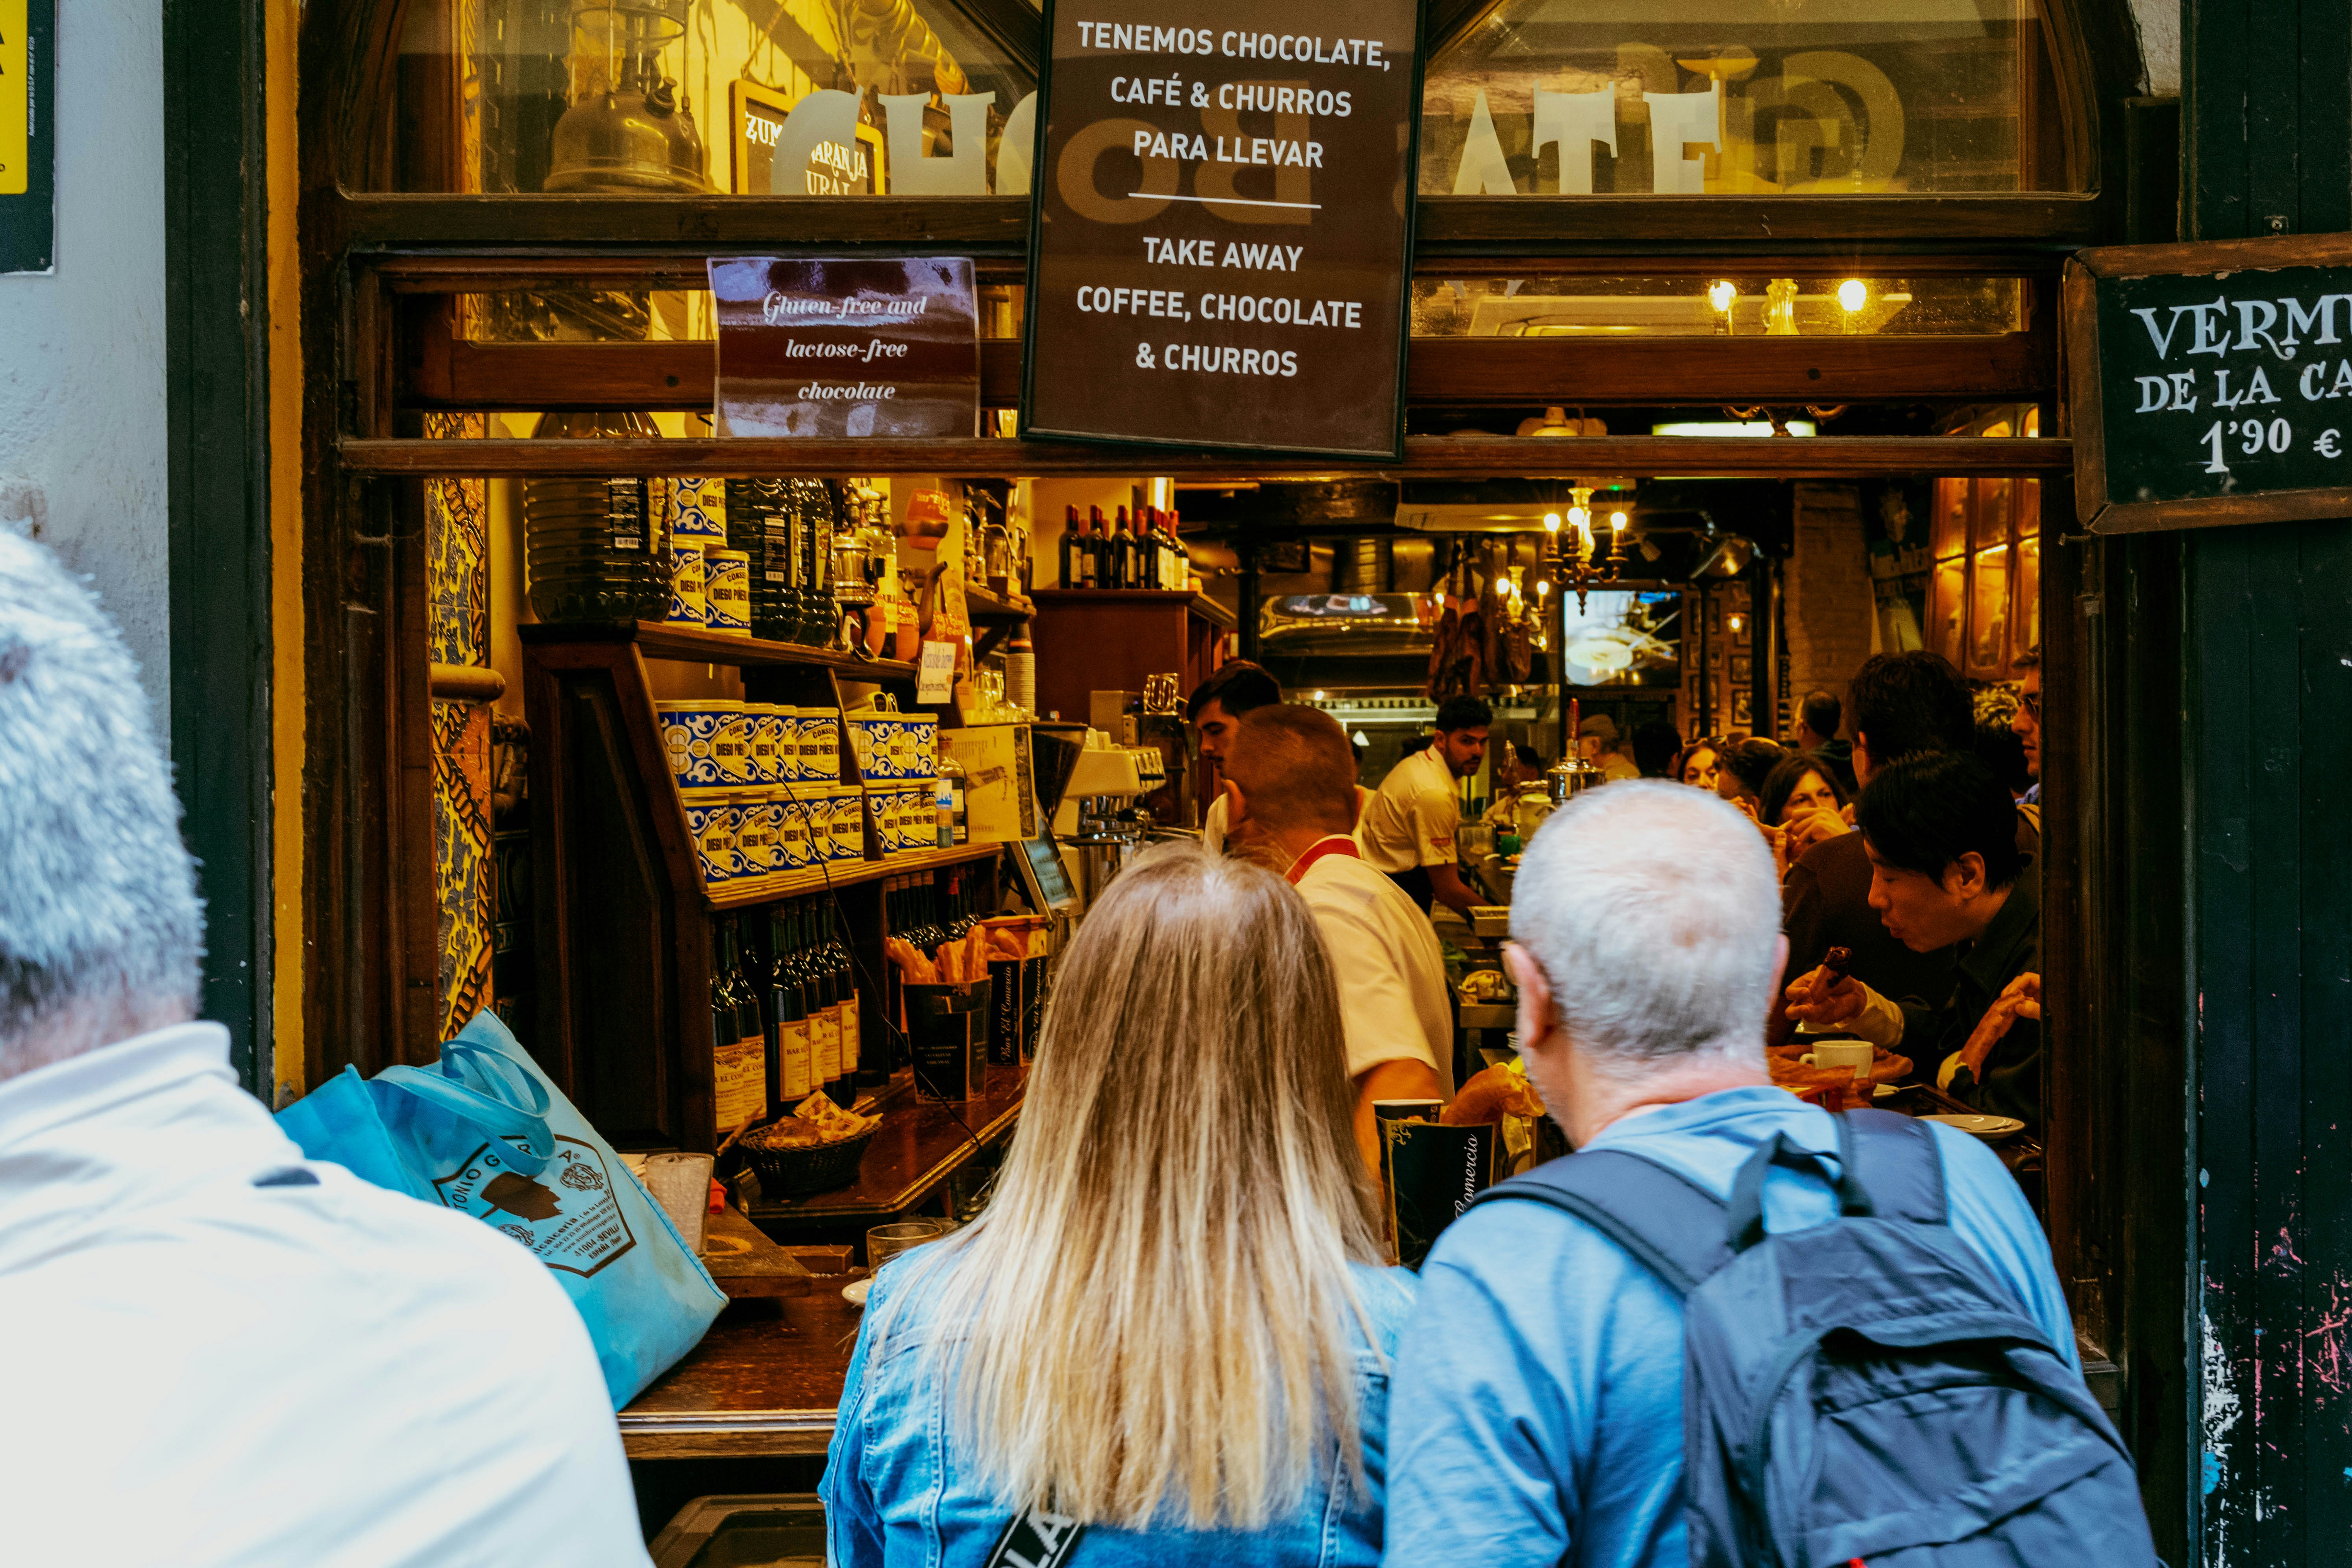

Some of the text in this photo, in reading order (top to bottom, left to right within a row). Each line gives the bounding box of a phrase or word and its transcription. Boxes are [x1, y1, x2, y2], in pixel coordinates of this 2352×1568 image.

[1077, 21, 1390, 72] TENEMOS CHOCOLATE,
[1110, 73, 1352, 117] CAFÉ & CHURROS
[745, 111, 783, 147] ZUM
[811, 141, 869, 181] ARANJA
[1134, 131, 1323, 168] PARA LLEVAR
[1143, 237, 1304, 272] TAKE AWAY
[763, 290, 927, 324] Gluten-free and
[1077, 286, 1362, 328] COFFEE, CHOCOLATE
[785, 338, 908, 363] lactose-free
[1135, 343, 1298, 377] & CHURROS
[798, 381, 897, 399] chocolate
[2134, 368, 2197, 414] DE
[2212, 366, 2281, 411] LA
[2200, 418, 2342, 473] 1'90 €
[713, 588, 732, 600] DIEGO
[716, 743, 733, 756] DIEGO
[799, 745, 817, 755] DIEGO
[706, 838, 722, 851] DIEGO
[743, 835, 758, 847] DIEGO
[832, 823, 849, 834] DIEGO
[1001, 965, 1011, 1061] Bar El Comercio
